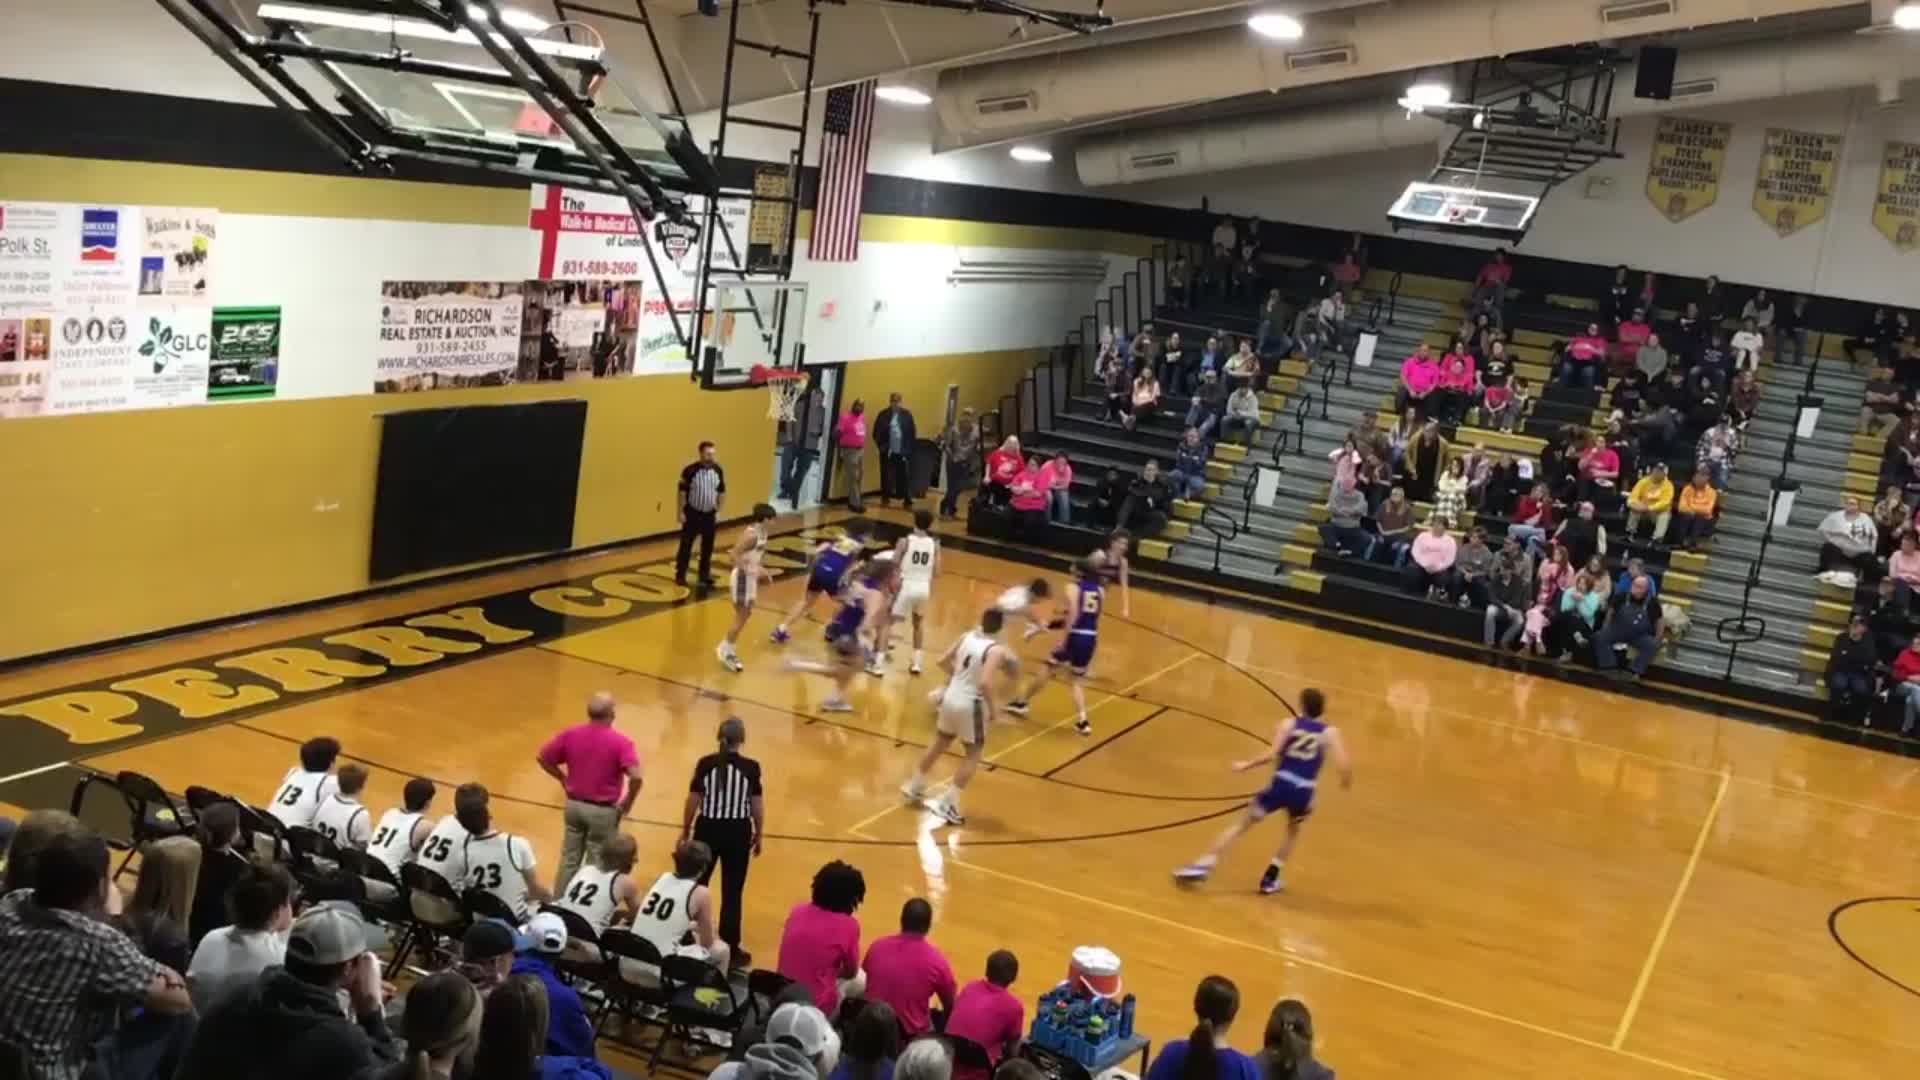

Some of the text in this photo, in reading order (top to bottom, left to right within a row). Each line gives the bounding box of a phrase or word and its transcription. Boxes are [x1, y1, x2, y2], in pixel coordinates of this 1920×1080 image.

[563, 196, 585, 211] The
[594, 215, 625, 232] Medical
[33, 237, 52, 254] St.
[605, 236, 646, 247] of Linde
[562, 260, 638, 275] 931-589-2600
[415, 308, 492, 324] RICHARDSON
[380, 327, 407, 341] REAL
[409, 326, 442, 340] ESTATE
[445, 326, 452, 339] &
[172, 333, 208, 352] GLC
[416, 340, 487, 353] 931-589-2455
[912, 551, 929, 566] 00
[2, 606, 534, 744] PERRY
[278, 784, 302, 805] 13
[370, 826, 398, 848] 31
[423, 834, 452, 862] 25
[473, 863, 502, 889] 23
[568, 880, 599, 906] 42
[642, 891, 675, 921] 30
